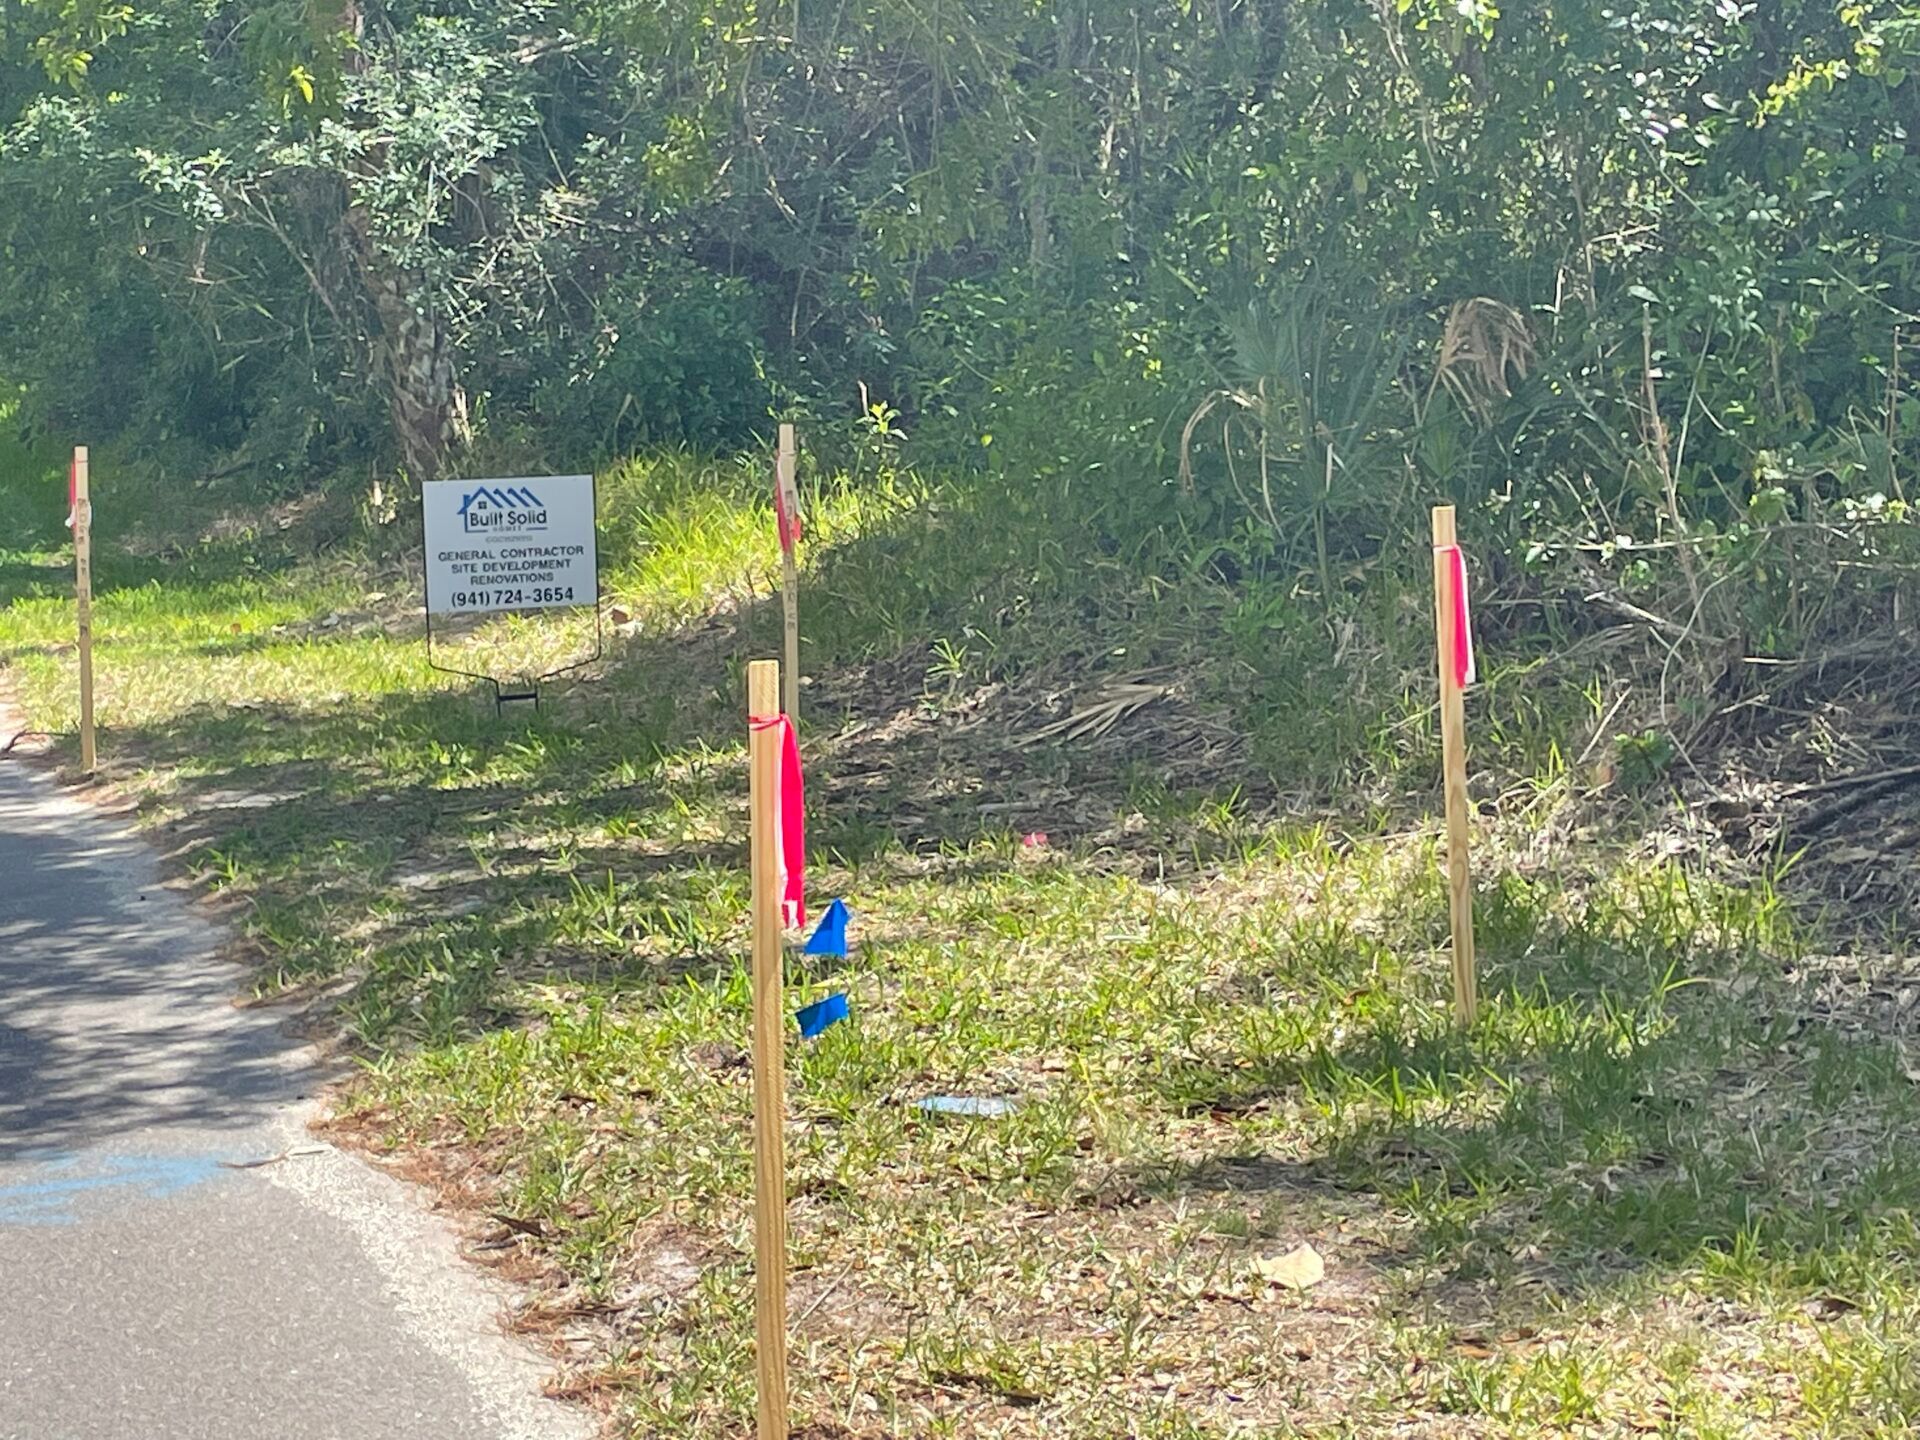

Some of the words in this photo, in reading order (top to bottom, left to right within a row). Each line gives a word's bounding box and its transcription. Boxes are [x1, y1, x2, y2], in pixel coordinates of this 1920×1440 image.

[470, 512, 503, 527] Built
[507, 510, 547, 525] Solid
[438, 550, 495, 562] GENERAL
[500, 545, 584, 559] CONTRACTOR
[451, 563, 478, 574] SITE
[483, 559, 571, 573] DEVELOPMENT
[470, 572, 554, 586] RENOVATIONS
[452, 591, 490, 608] (941)
[494, 587, 574, 605] 724-3654
